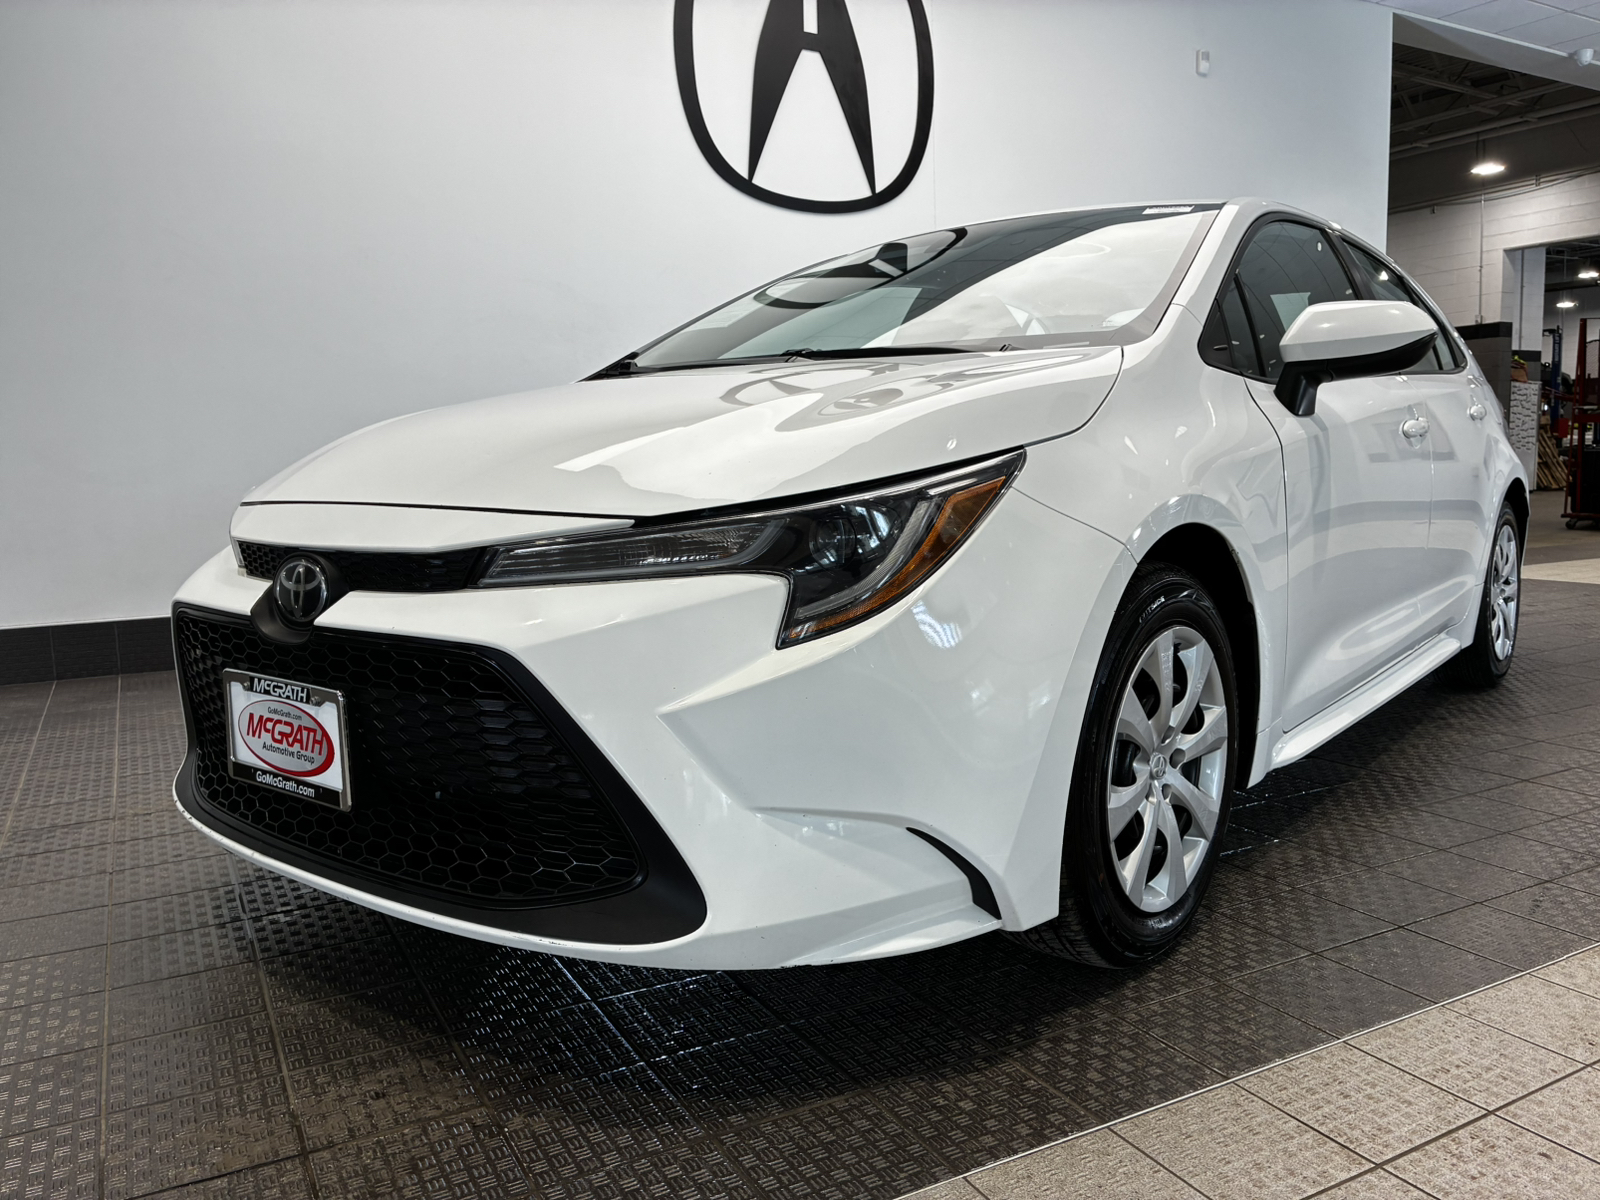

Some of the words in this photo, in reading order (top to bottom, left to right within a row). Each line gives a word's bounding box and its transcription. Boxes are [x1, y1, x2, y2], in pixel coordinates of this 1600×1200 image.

[267, 706, 302, 721] GoMcGrath.com
[262, 741, 295, 758] Automotive
[296, 751, 315, 765] Group
[256, 771, 315, 797] GoMcGrath.com
